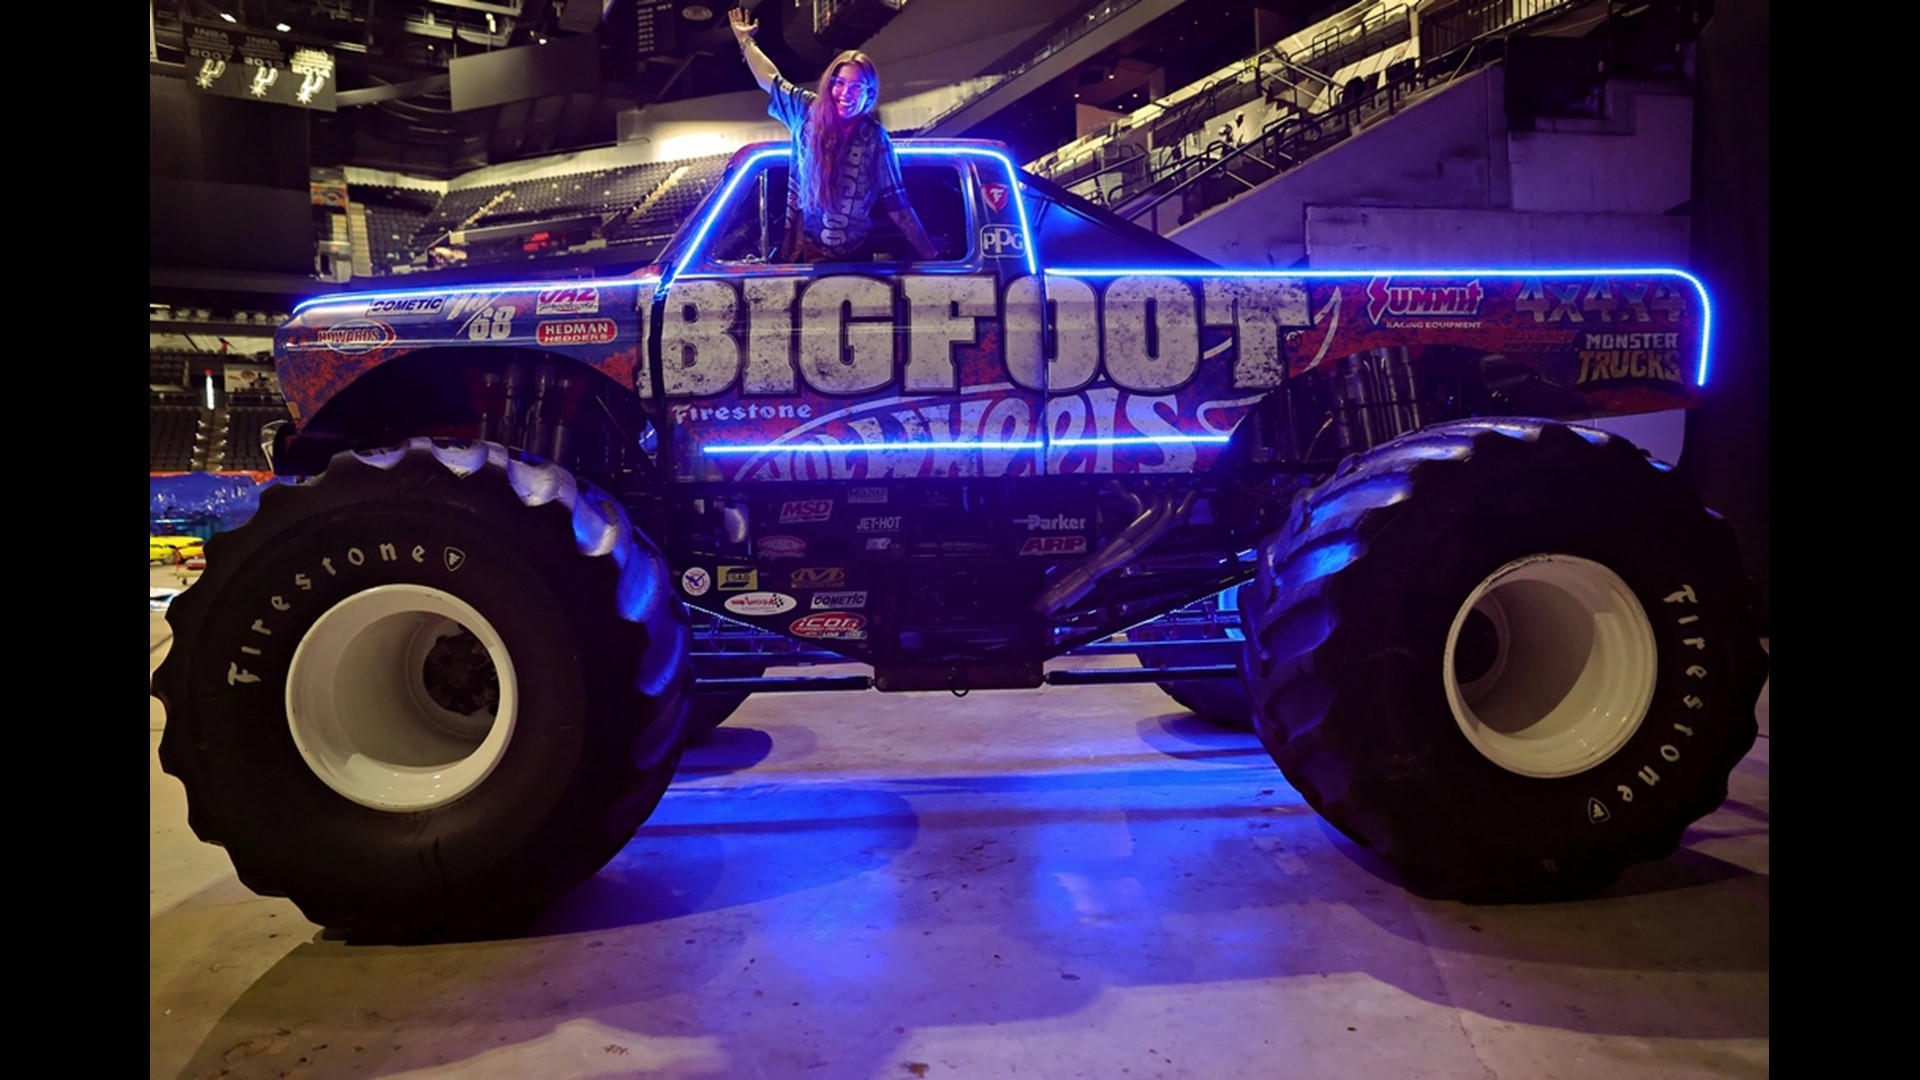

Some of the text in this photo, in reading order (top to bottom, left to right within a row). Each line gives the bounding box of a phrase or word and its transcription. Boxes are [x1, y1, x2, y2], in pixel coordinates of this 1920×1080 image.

[371, 297, 443, 312] COMETIC
[545, 323, 608, 335] HEDMAN
[1386, 321, 1482, 329] RACING EQUIPMENT
[318, 328, 380, 343] HOWARDS
[636, 274, 1313, 399] BIGFOOT
[1585, 332, 1680, 350] MONSTER
[1576, 350, 1683, 385] TRUCKS
[671, 403, 812, 424] Firestone
[782, 501, 830, 517] MSD
[1027, 514, 1086, 530] Parker
[1020, 537, 1086, 555] ARP
[813, 593, 864, 606] COMETIC
[227, 542, 426, 686] Firestone
[1617, 584, 1708, 802] Firestone
